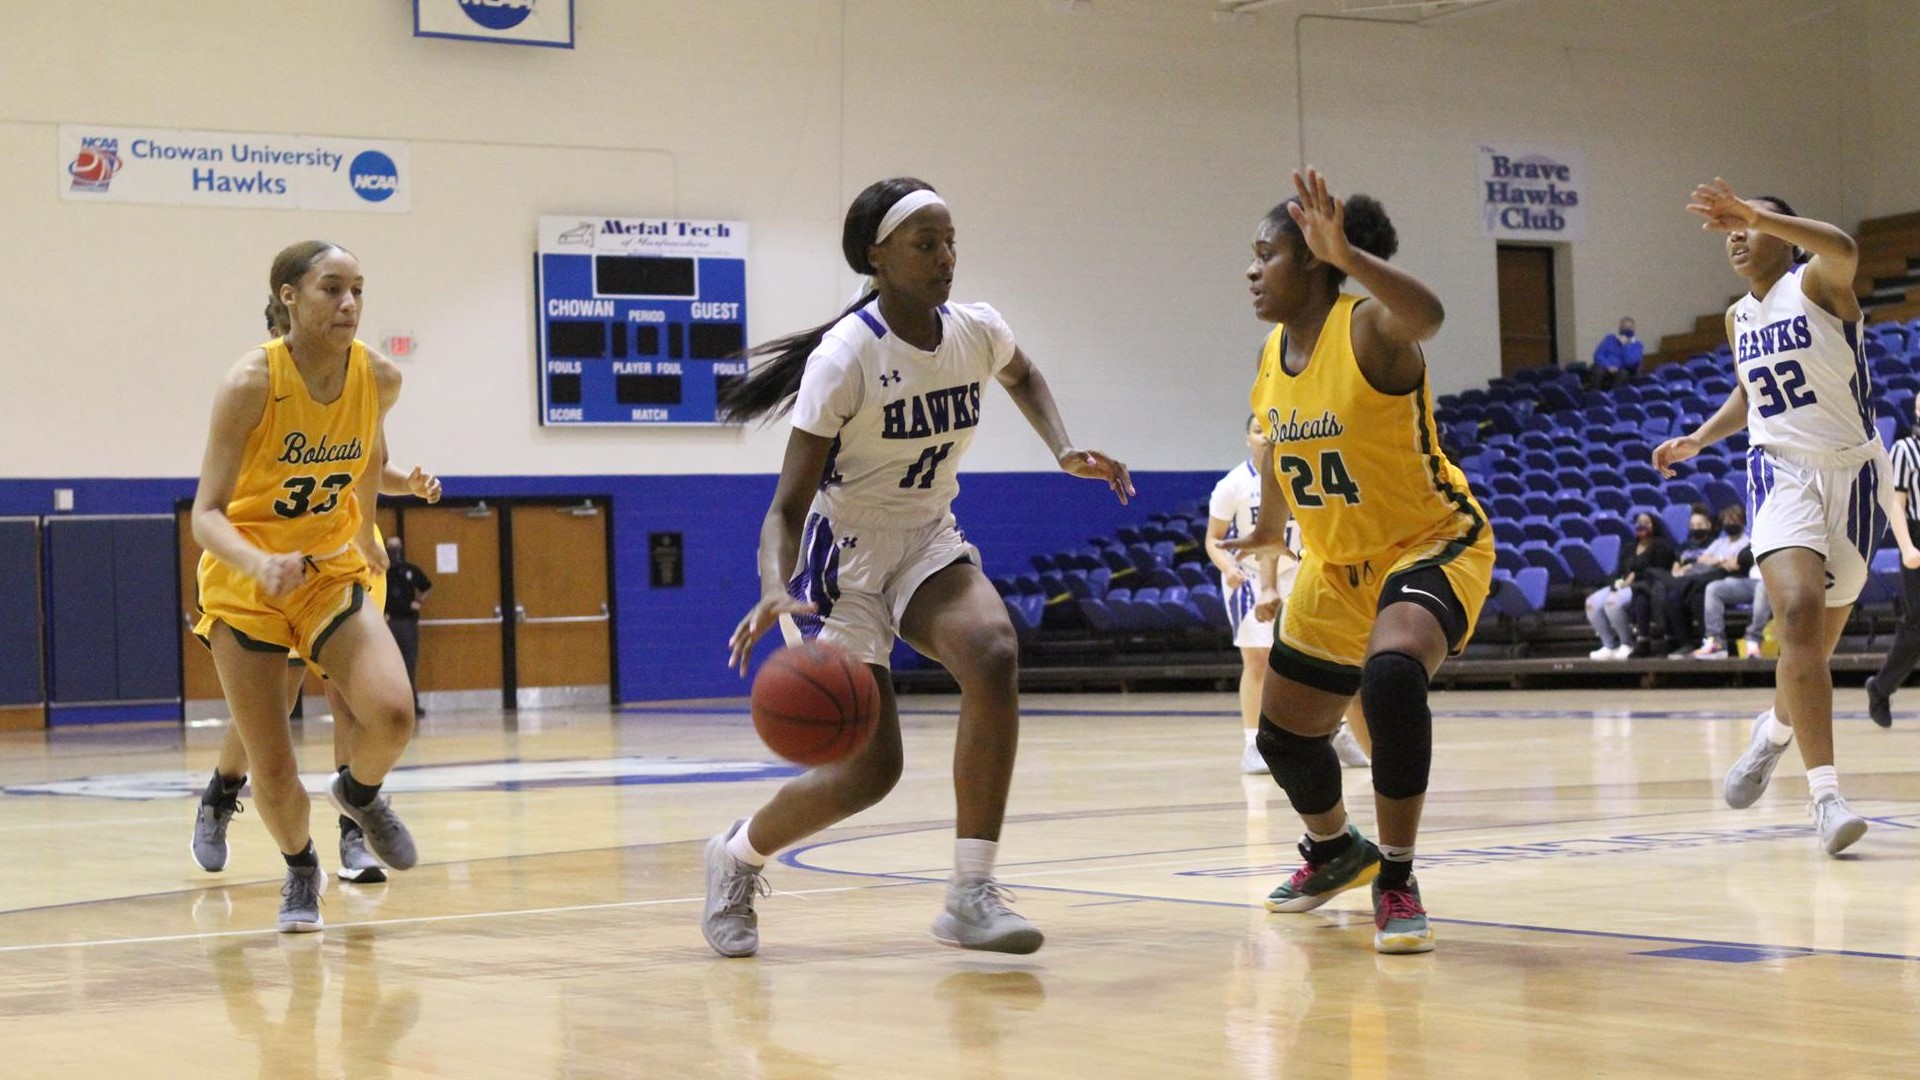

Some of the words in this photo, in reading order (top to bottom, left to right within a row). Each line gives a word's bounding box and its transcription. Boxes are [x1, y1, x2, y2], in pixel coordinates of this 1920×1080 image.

[81, 136, 118, 149] NCAA
[131, 139, 223, 162] Chowan
[231, 144, 342, 172] University
[1491, 155, 1570, 181] Brave
[192, 168, 286, 194] Hawks
[354, 174, 398, 190] NCAA
[1485, 181, 1579, 206] Hawks
[601, 220, 668, 236] Metal
[673, 221, 730, 238] Tech
[1500, 206, 1566, 231] Club
[548, 300, 615, 317] CHOWAN
[628, 310, 666, 322] PERIOD
[690, 302, 739, 320] GUEST
[1738, 314, 1812, 364] HAWKS
[548, 361, 582, 374] FOULS
[612, 361, 652, 374] PLAYER
[656, 362, 683, 375] FOUL
[712, 362, 745, 375] FOULS
[1748, 359, 1818, 419] 32
[549, 408, 583, 421] SCORE
[631, 408, 669, 421] MATCH
[881, 381, 980, 439] HAWKS
[1268, 407, 1344, 443] Bobcats
[277, 431, 363, 465] Bobcats
[898, 441, 955, 489] 11
[1279, 450, 1361, 506] 24
[273, 472, 353, 518] 33
